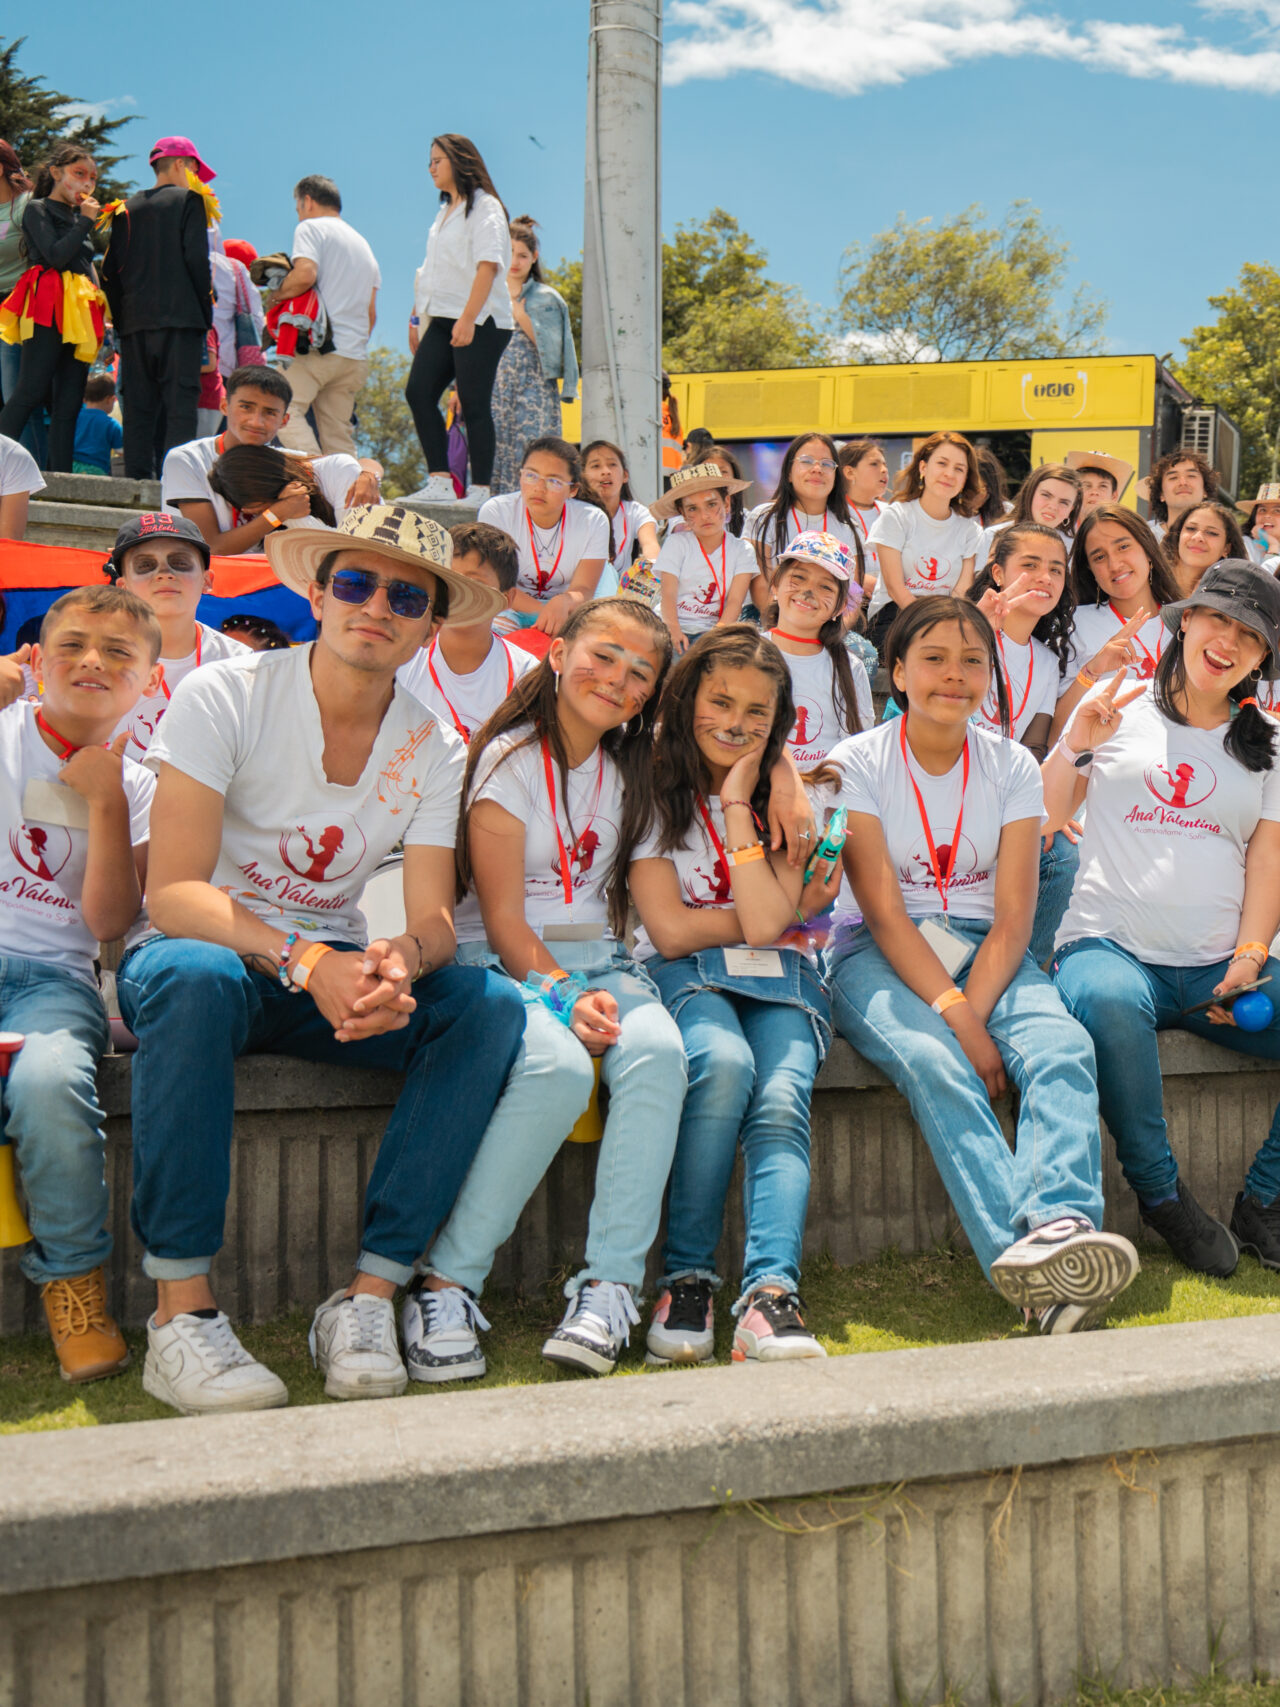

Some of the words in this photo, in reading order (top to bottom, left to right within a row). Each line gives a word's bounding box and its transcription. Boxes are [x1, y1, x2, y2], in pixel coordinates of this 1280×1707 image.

[1123, 804, 1155, 824] Ana
[1153, 805, 1222, 834] Valentina
[238, 861, 275, 891] Ana
